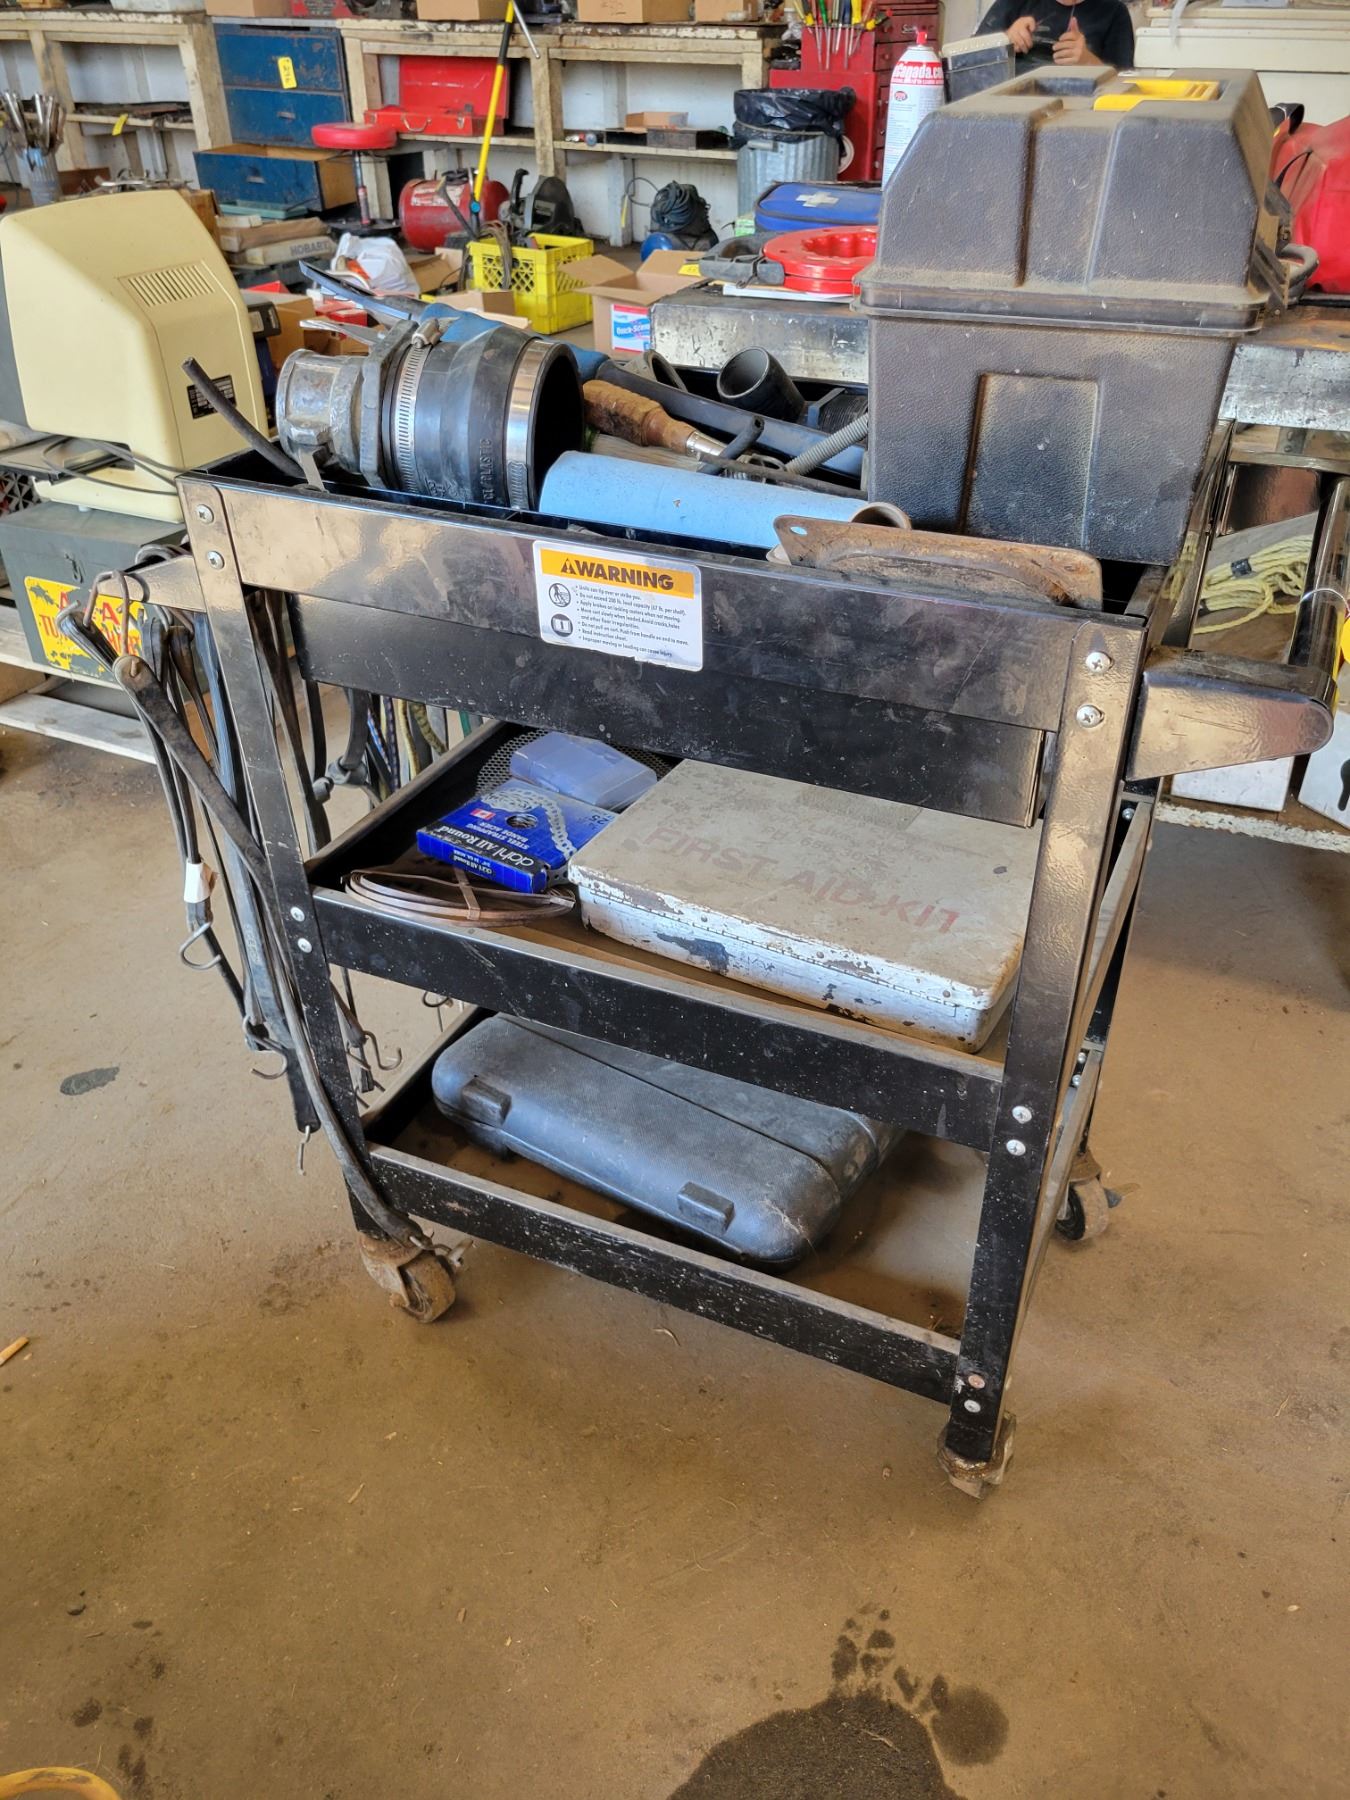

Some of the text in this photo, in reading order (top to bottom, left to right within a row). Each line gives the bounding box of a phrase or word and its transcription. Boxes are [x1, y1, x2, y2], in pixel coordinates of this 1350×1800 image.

[575, 560, 674, 590] WARNING
[436, 825, 479, 845] Round
[465, 823, 530, 850] STEEL STRAPPING
[476, 840, 499, 852] All
[492, 847, 534, 867] dahl
[642, 826, 779, 880] FIRST
[780, 869, 872, 907] AID
[878, 893, 961, 934] KIT
